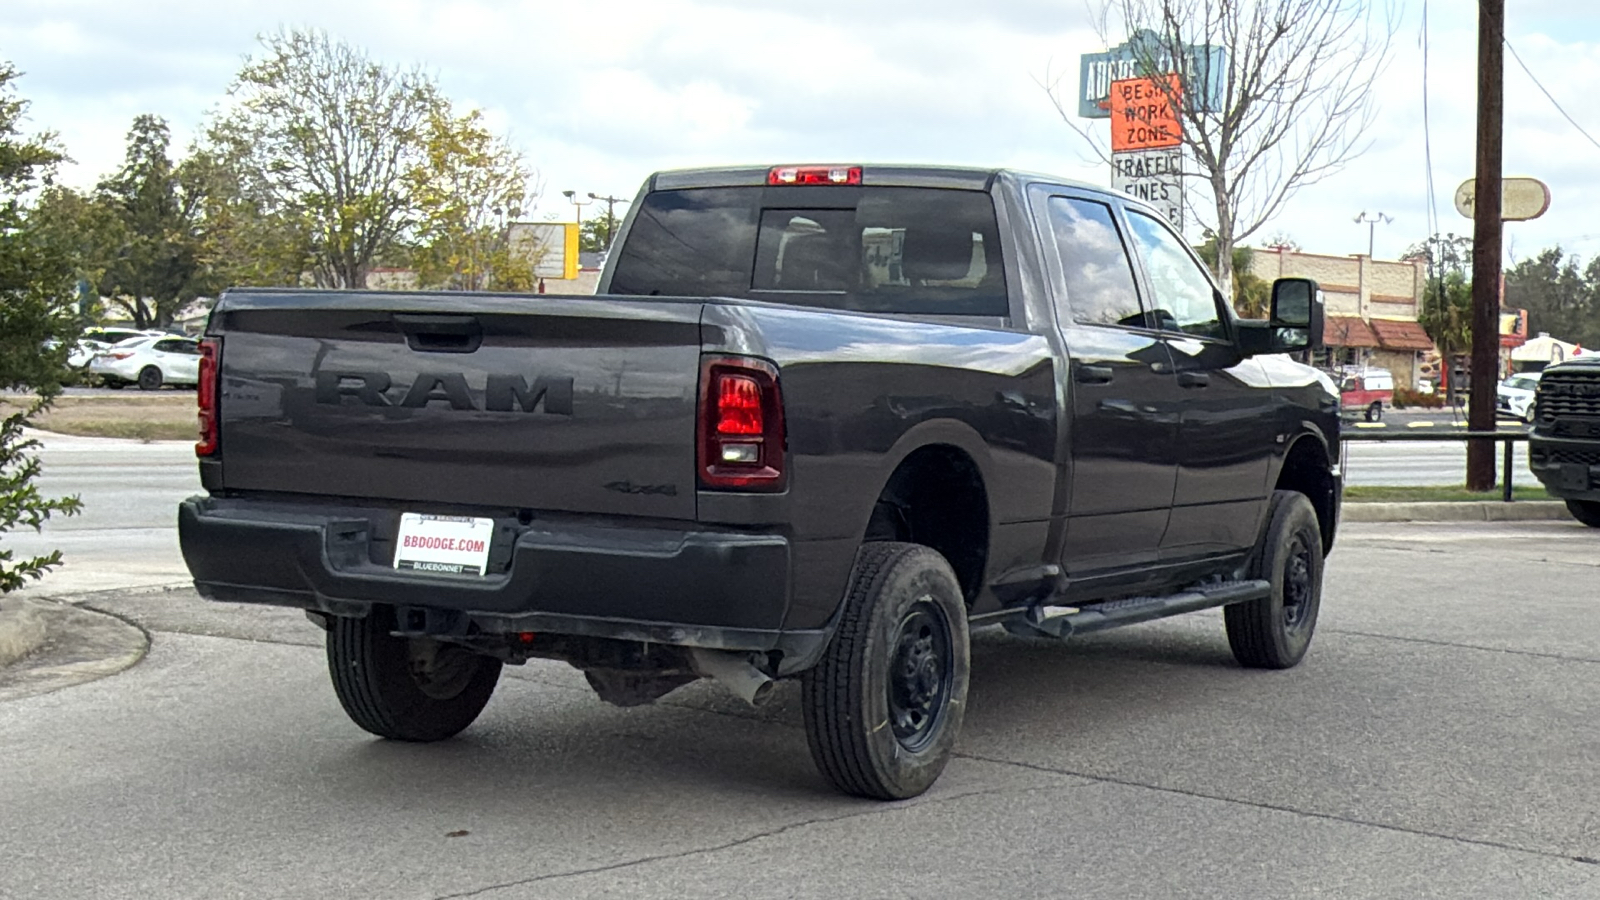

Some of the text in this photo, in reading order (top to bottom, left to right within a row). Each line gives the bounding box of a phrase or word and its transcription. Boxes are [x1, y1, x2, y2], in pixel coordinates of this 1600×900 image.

[1125, 103, 1168, 122] WORK
[1128, 125, 1168, 144] ZONE
[1115, 155, 1180, 178] TRAFFIC
[1125, 182, 1169, 201] FINES
[315, 370, 574, 415] RAM
[403, 535, 485, 553] BBDODGE.COM
[413, 561, 464, 573] BLUEBONNET
